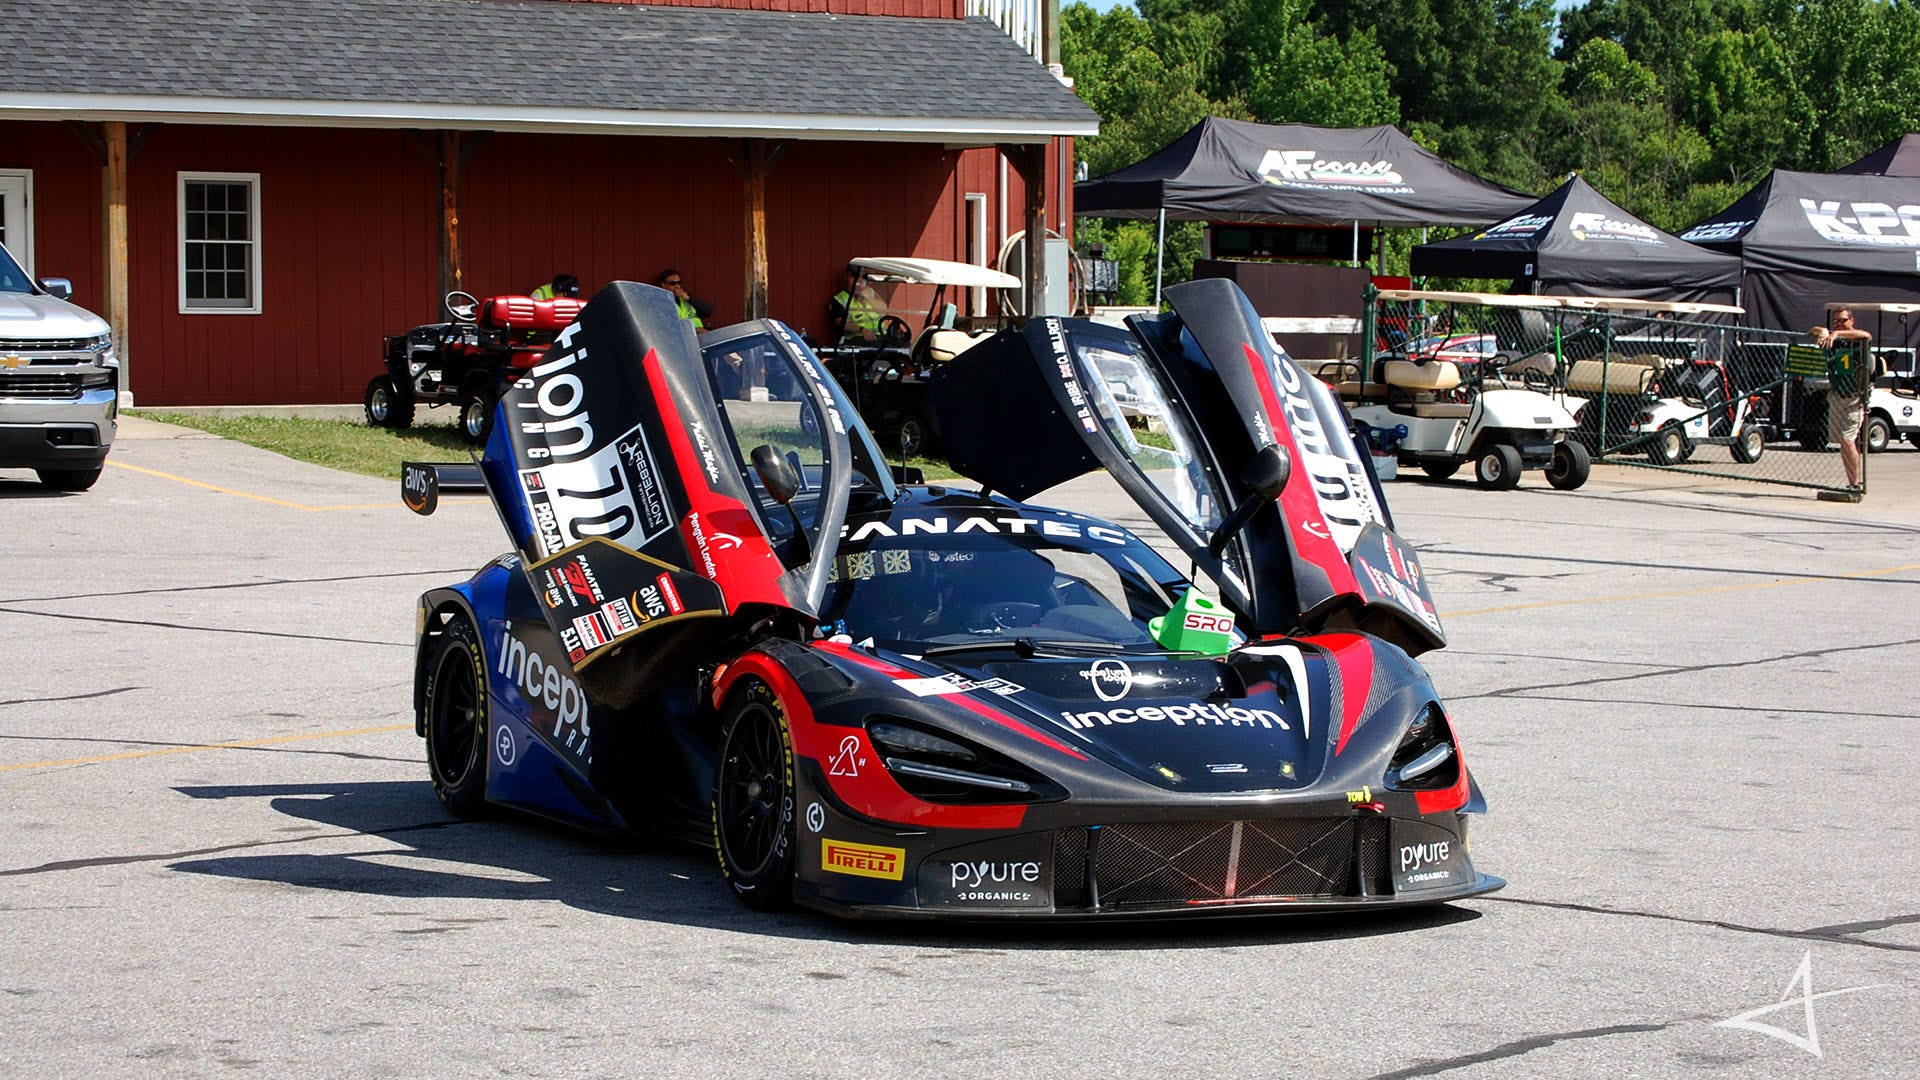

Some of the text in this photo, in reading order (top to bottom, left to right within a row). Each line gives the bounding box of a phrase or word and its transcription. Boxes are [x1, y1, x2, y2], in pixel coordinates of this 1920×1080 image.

[1257, 149, 1316, 180] AF
[1841, 354, 1850, 370] 1
[1064, 380, 1086, 407] IRIBE
[406, 466, 426, 494] aws
[634, 450, 665, 526] REBELLION
[557, 464, 635, 541] 70
[534, 502, 564, 555] PRO-AM
[689, 512, 717, 579] Penguin London
[576, 554, 605, 602] FANATEC
[550, 588, 564, 606] aws
[640, 584, 666, 617] aws
[612, 600, 634, 629] OPTIMA
[1185, 613, 1233, 633] SRO
[586, 628, 597, 646] Barber
[1061, 702, 1290, 731] inception
[777, 715, 793, 788] ZERO
[1346, 791, 1364, 802] TOW
[828, 845, 896, 873] PIRELLI
[1400, 841, 1449, 871] pyure
[950, 860, 1040, 888] pyure
